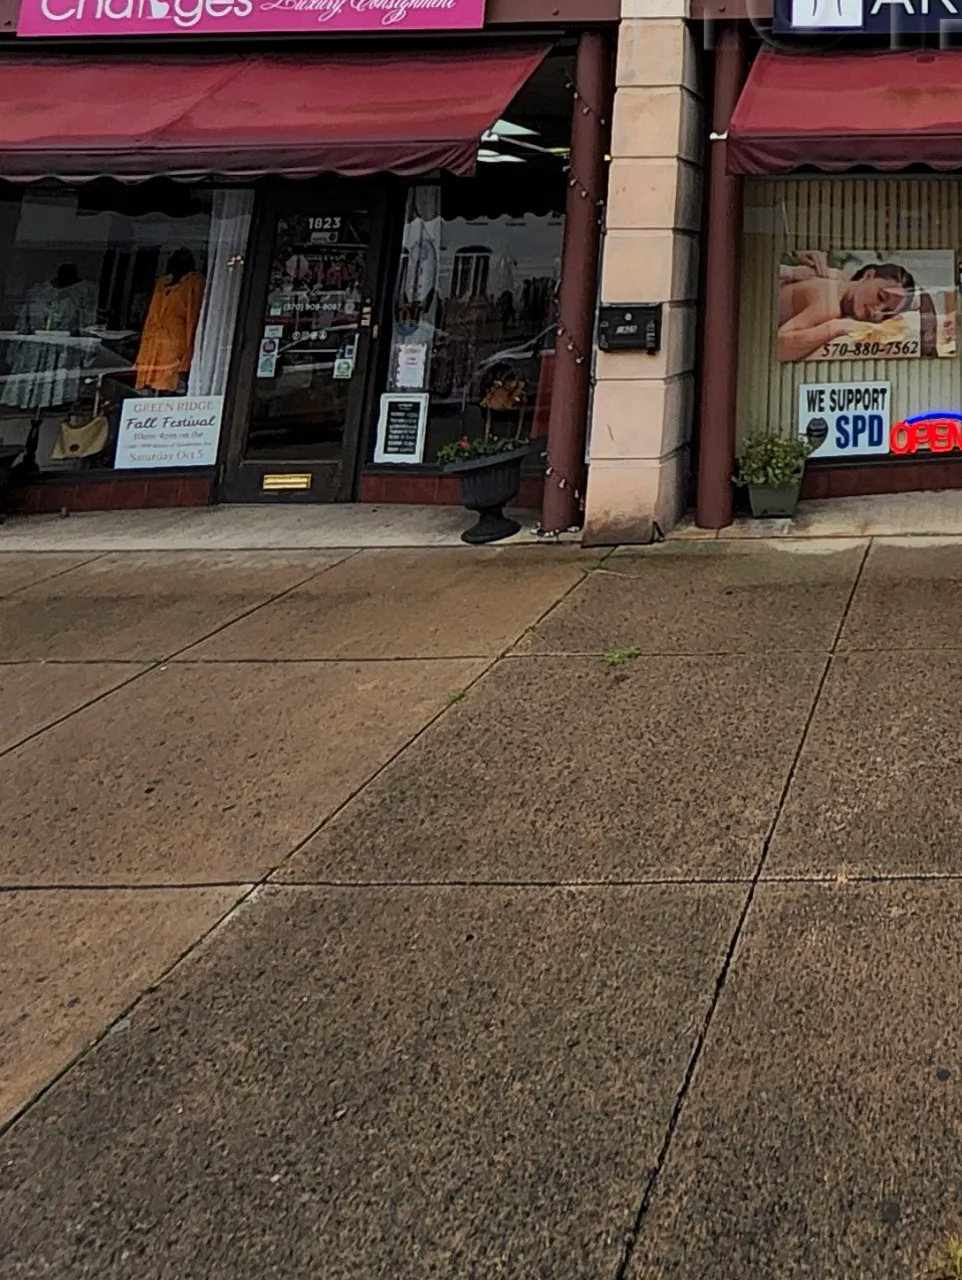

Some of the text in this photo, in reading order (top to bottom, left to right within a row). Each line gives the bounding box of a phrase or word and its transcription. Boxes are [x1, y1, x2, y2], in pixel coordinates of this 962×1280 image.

[309, 216, 341, 230] 1823
[821, 341, 919, 357] 570-880-7562
[133, 400, 214, 414] GREEN RIDGE
[807, 388, 887, 412] WE SUPPORT
[126, 415, 217, 430] Fall Festival
[836, 414, 884, 449] SPD
[176, 450, 196, 461] Oct
